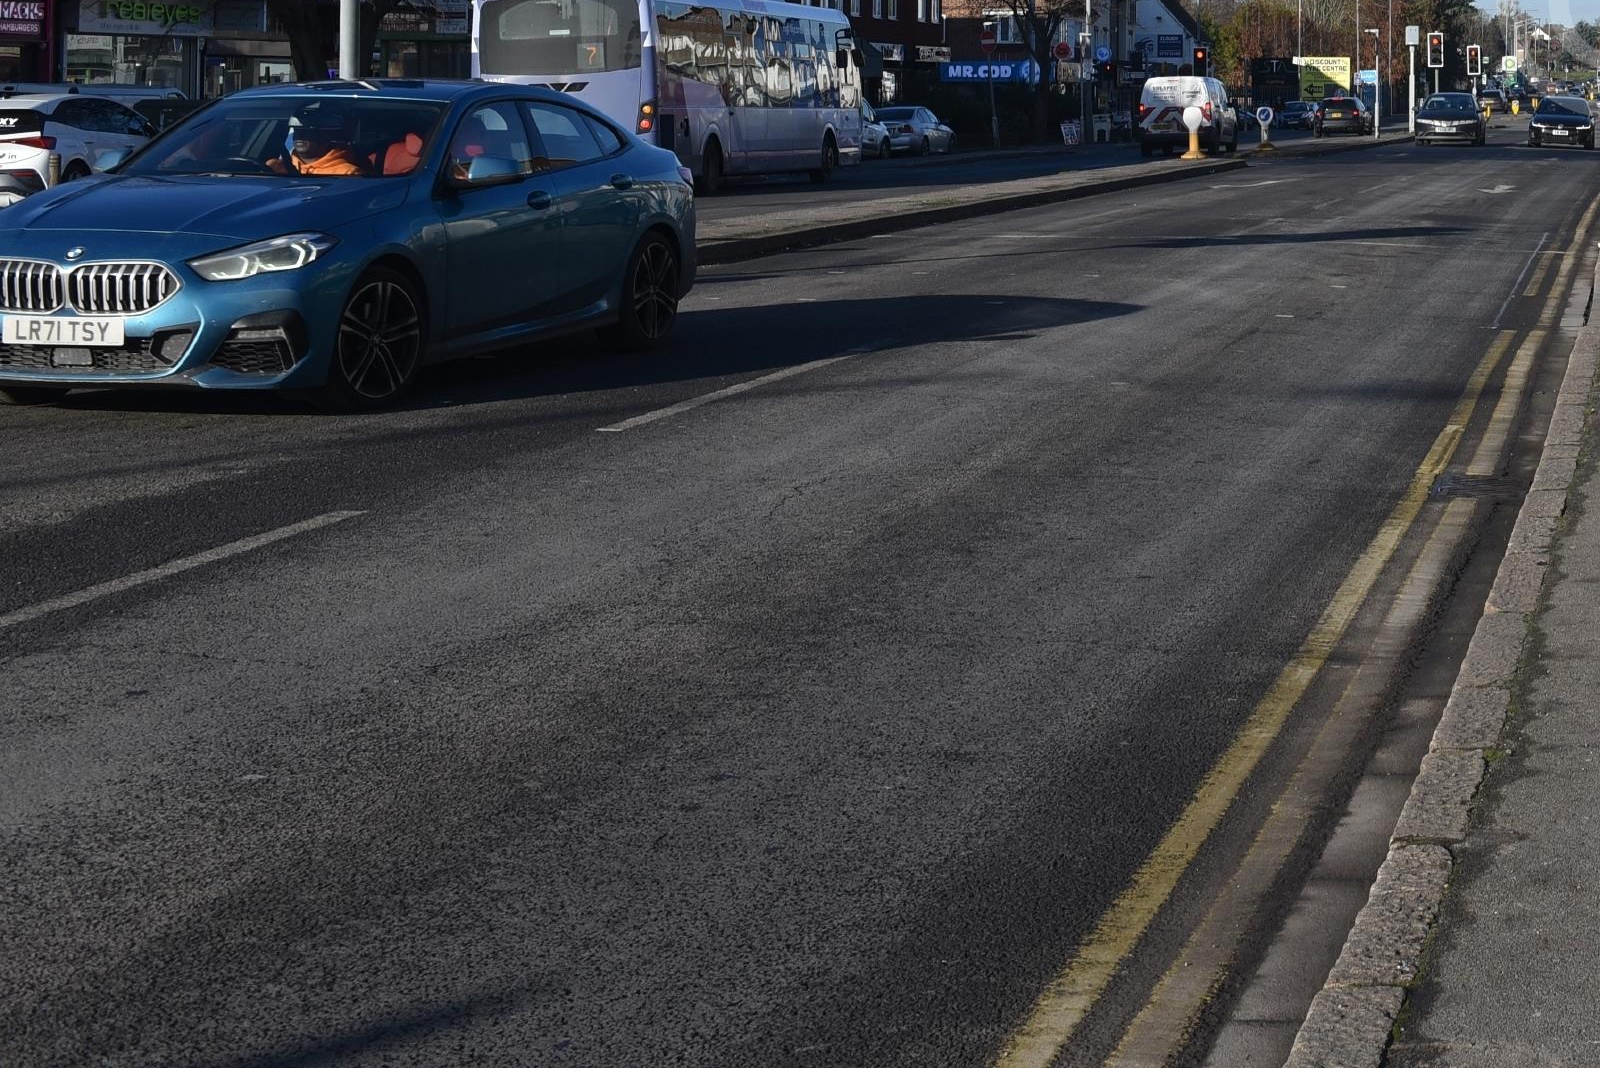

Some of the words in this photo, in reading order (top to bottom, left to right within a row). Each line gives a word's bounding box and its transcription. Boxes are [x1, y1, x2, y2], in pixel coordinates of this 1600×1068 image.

[586, 46, 597, 65] 7
[948, 64, 1012, 78] MR.COD
[15, 319, 60, 341] LR71
[68, 321, 109, 342] TSY
